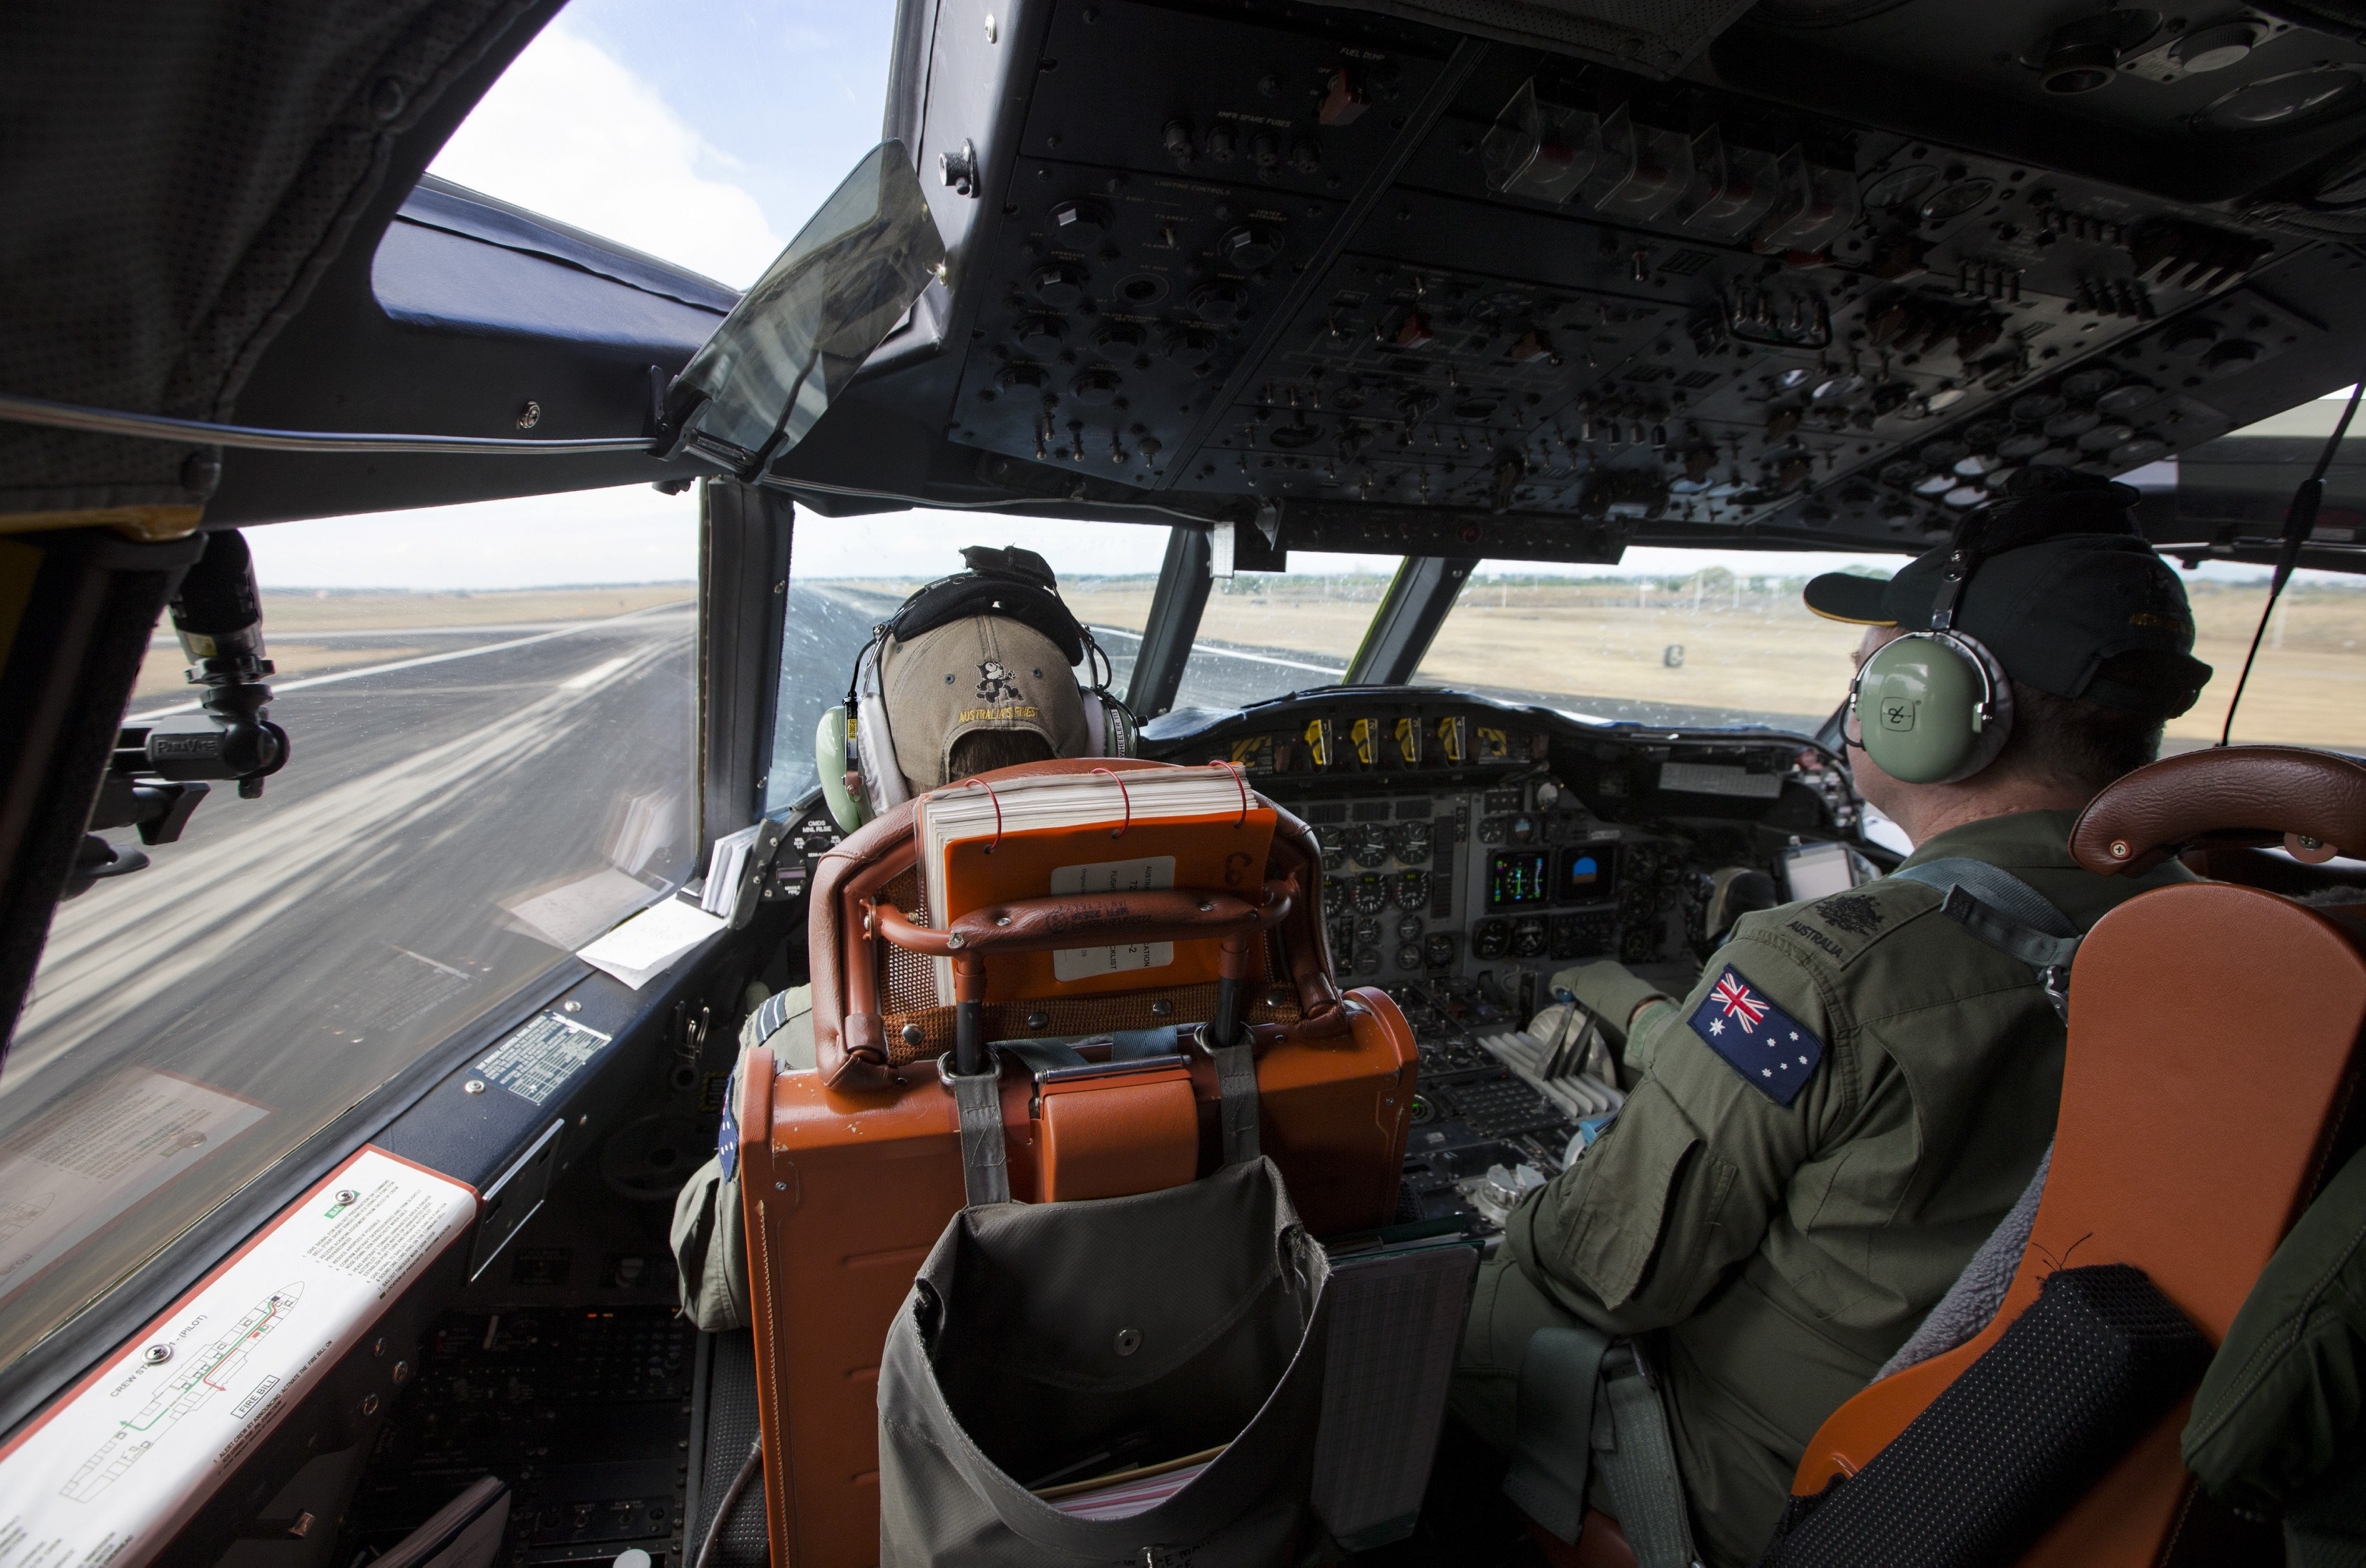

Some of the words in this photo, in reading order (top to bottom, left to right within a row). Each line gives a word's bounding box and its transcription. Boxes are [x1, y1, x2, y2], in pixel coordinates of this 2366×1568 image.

[1340, 47, 1360, 57] FUEL
[1363, 53, 1385, 61] DUMP
[1241, 114, 1264, 124] SPARE
[1266, 118, 1291, 127] FUSES
[1155, 180, 1188, 190] LIGHTING
[1191, 185, 1231, 195] CONTROLS
[1155, 214, 1189, 222] FILAMENT
[959, 707, 1012, 722] AUSTRALIA'S
[1014, 706, 1040, 719] FINEST
[1116, 722, 1125, 758] WHEELER
[1786, 920, 1844, 957] AUSTRALIA
[109, 1373, 137, 1399] CREW
[177, 1312, 208, 1339] (PILOT)
[238, 1395, 259, 1412] FIRE
[255, 1377, 275, 1395] BILL
[217, 1442, 235, 1458] ALERT
[232, 1429, 248, 1442] CREW
[251, 1393, 282, 1422] ANNOUNCING
[297, 1365, 309, 1374] THE
[258, 1399, 283, 1423] FUNCTION
